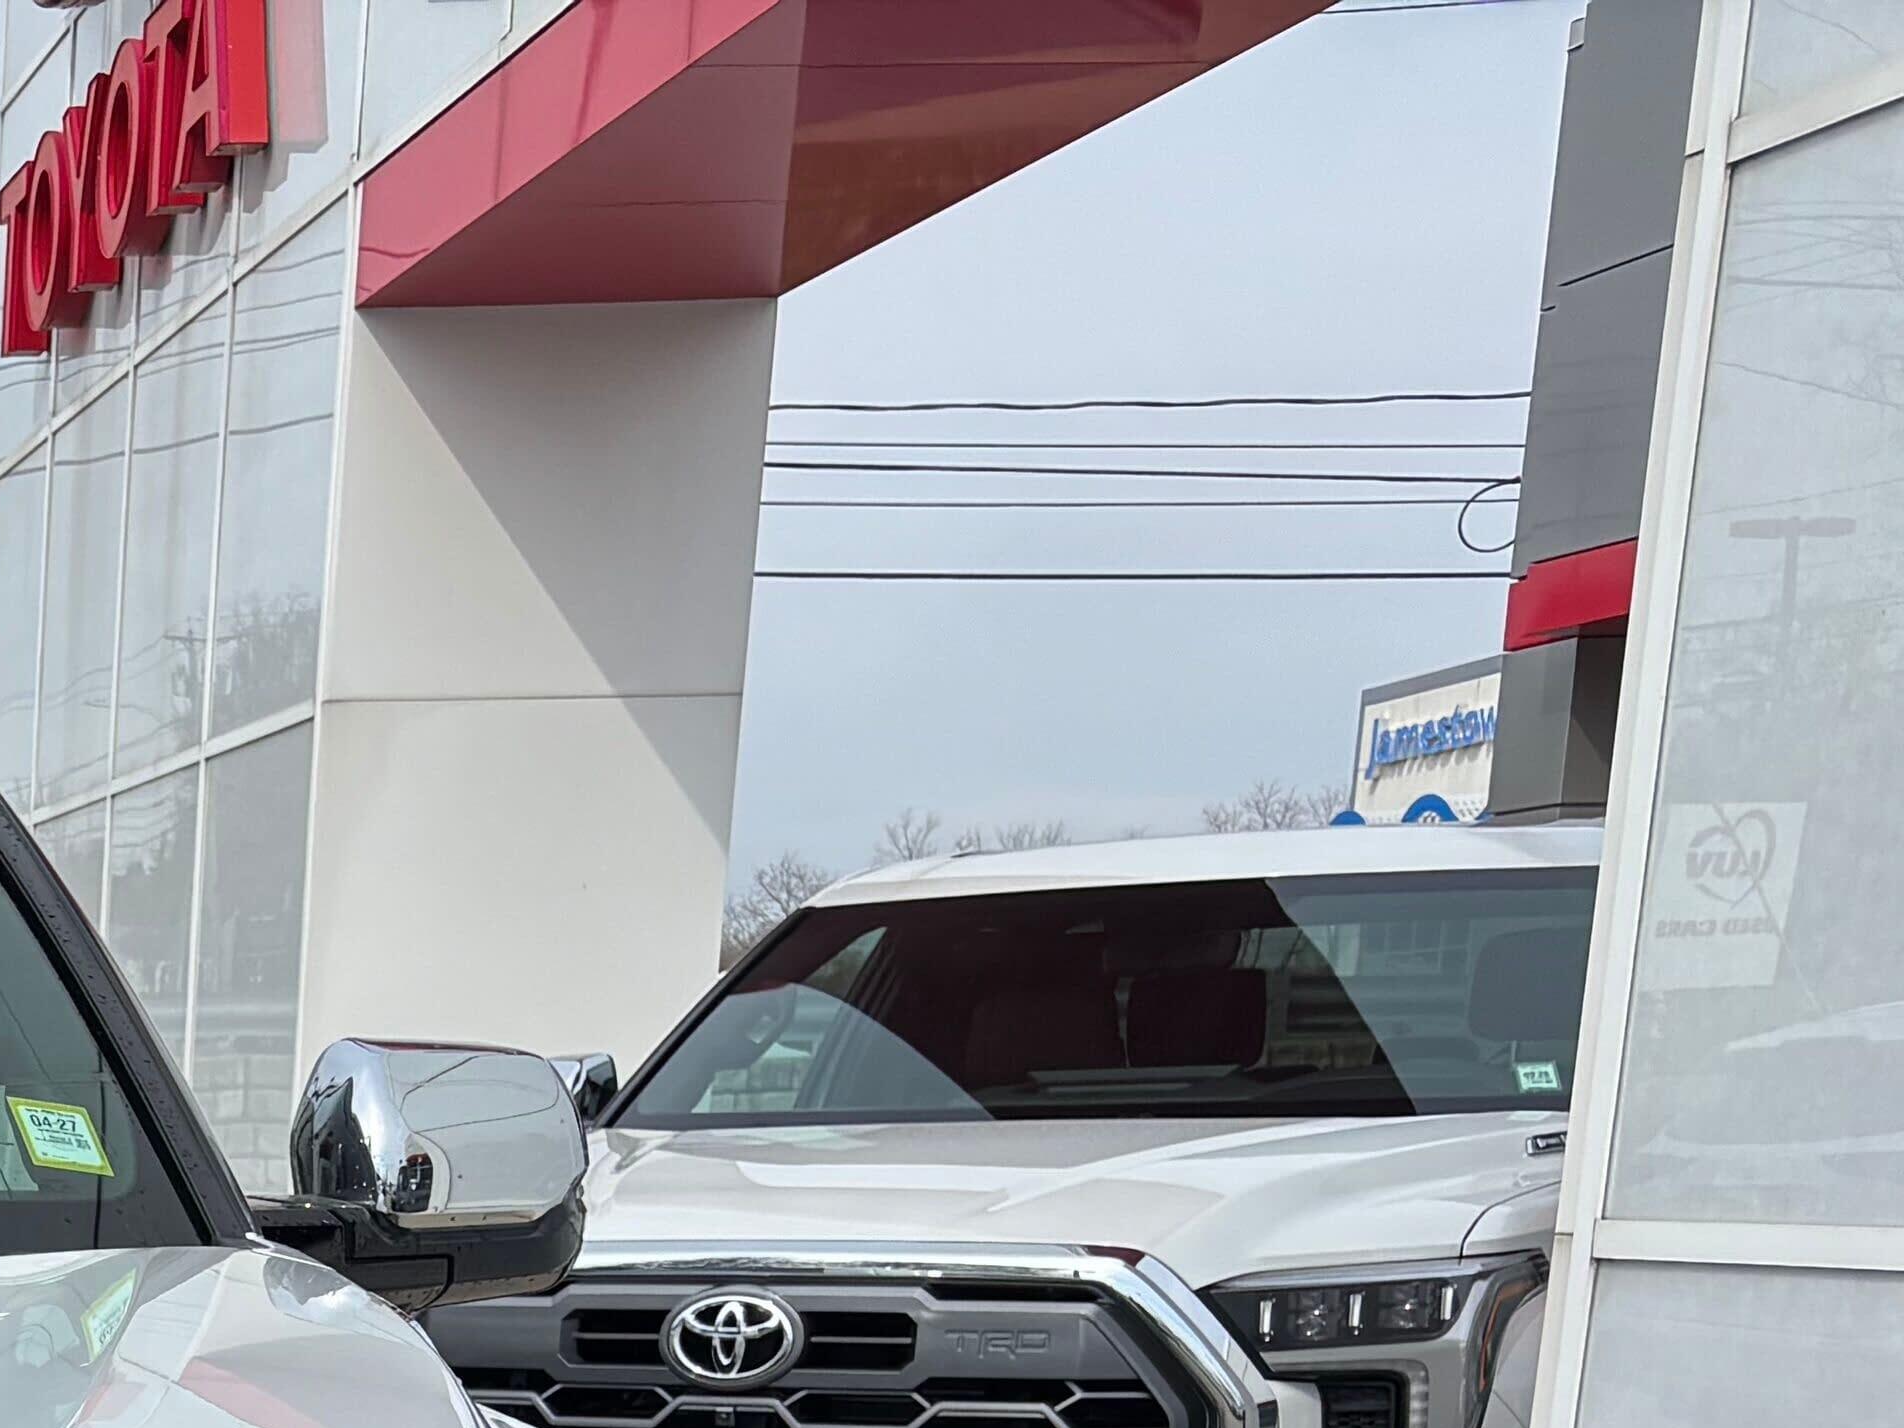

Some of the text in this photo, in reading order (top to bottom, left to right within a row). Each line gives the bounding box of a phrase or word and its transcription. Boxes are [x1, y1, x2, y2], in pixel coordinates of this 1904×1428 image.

[0, 0, 268, 357] TOYOTA
[29, 1113, 77, 1133] 04-27
[944, 1328, 1052, 1360] TRD
